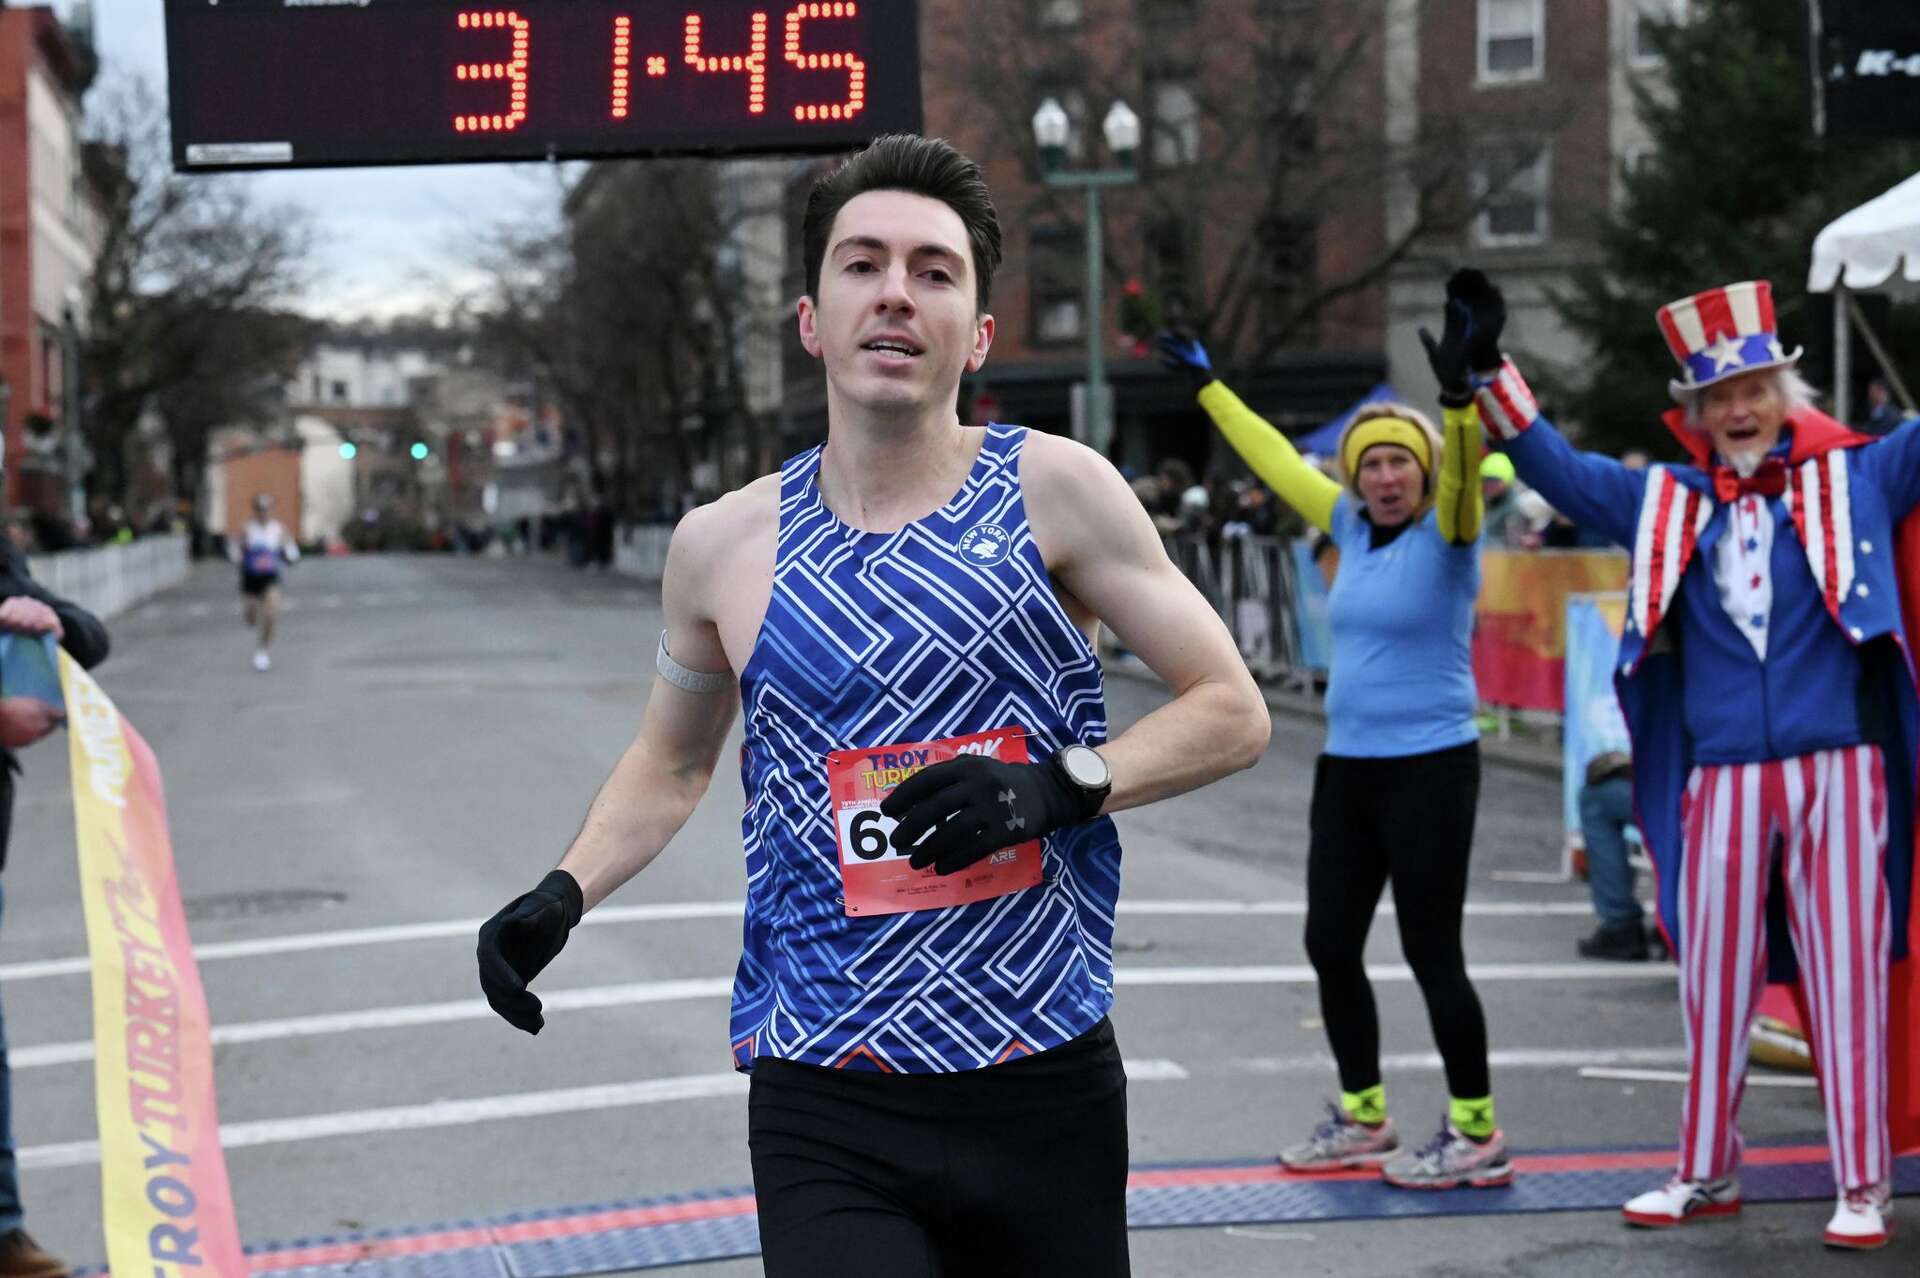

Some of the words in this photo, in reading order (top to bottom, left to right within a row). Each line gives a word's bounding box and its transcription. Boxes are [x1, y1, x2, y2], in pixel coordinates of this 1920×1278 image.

[961, 529, 978, 550] NEW
[980, 526, 1007, 543] YORK
[867, 749, 929, 770] TROY
[115, 926, 189, 1132] TURKEY
